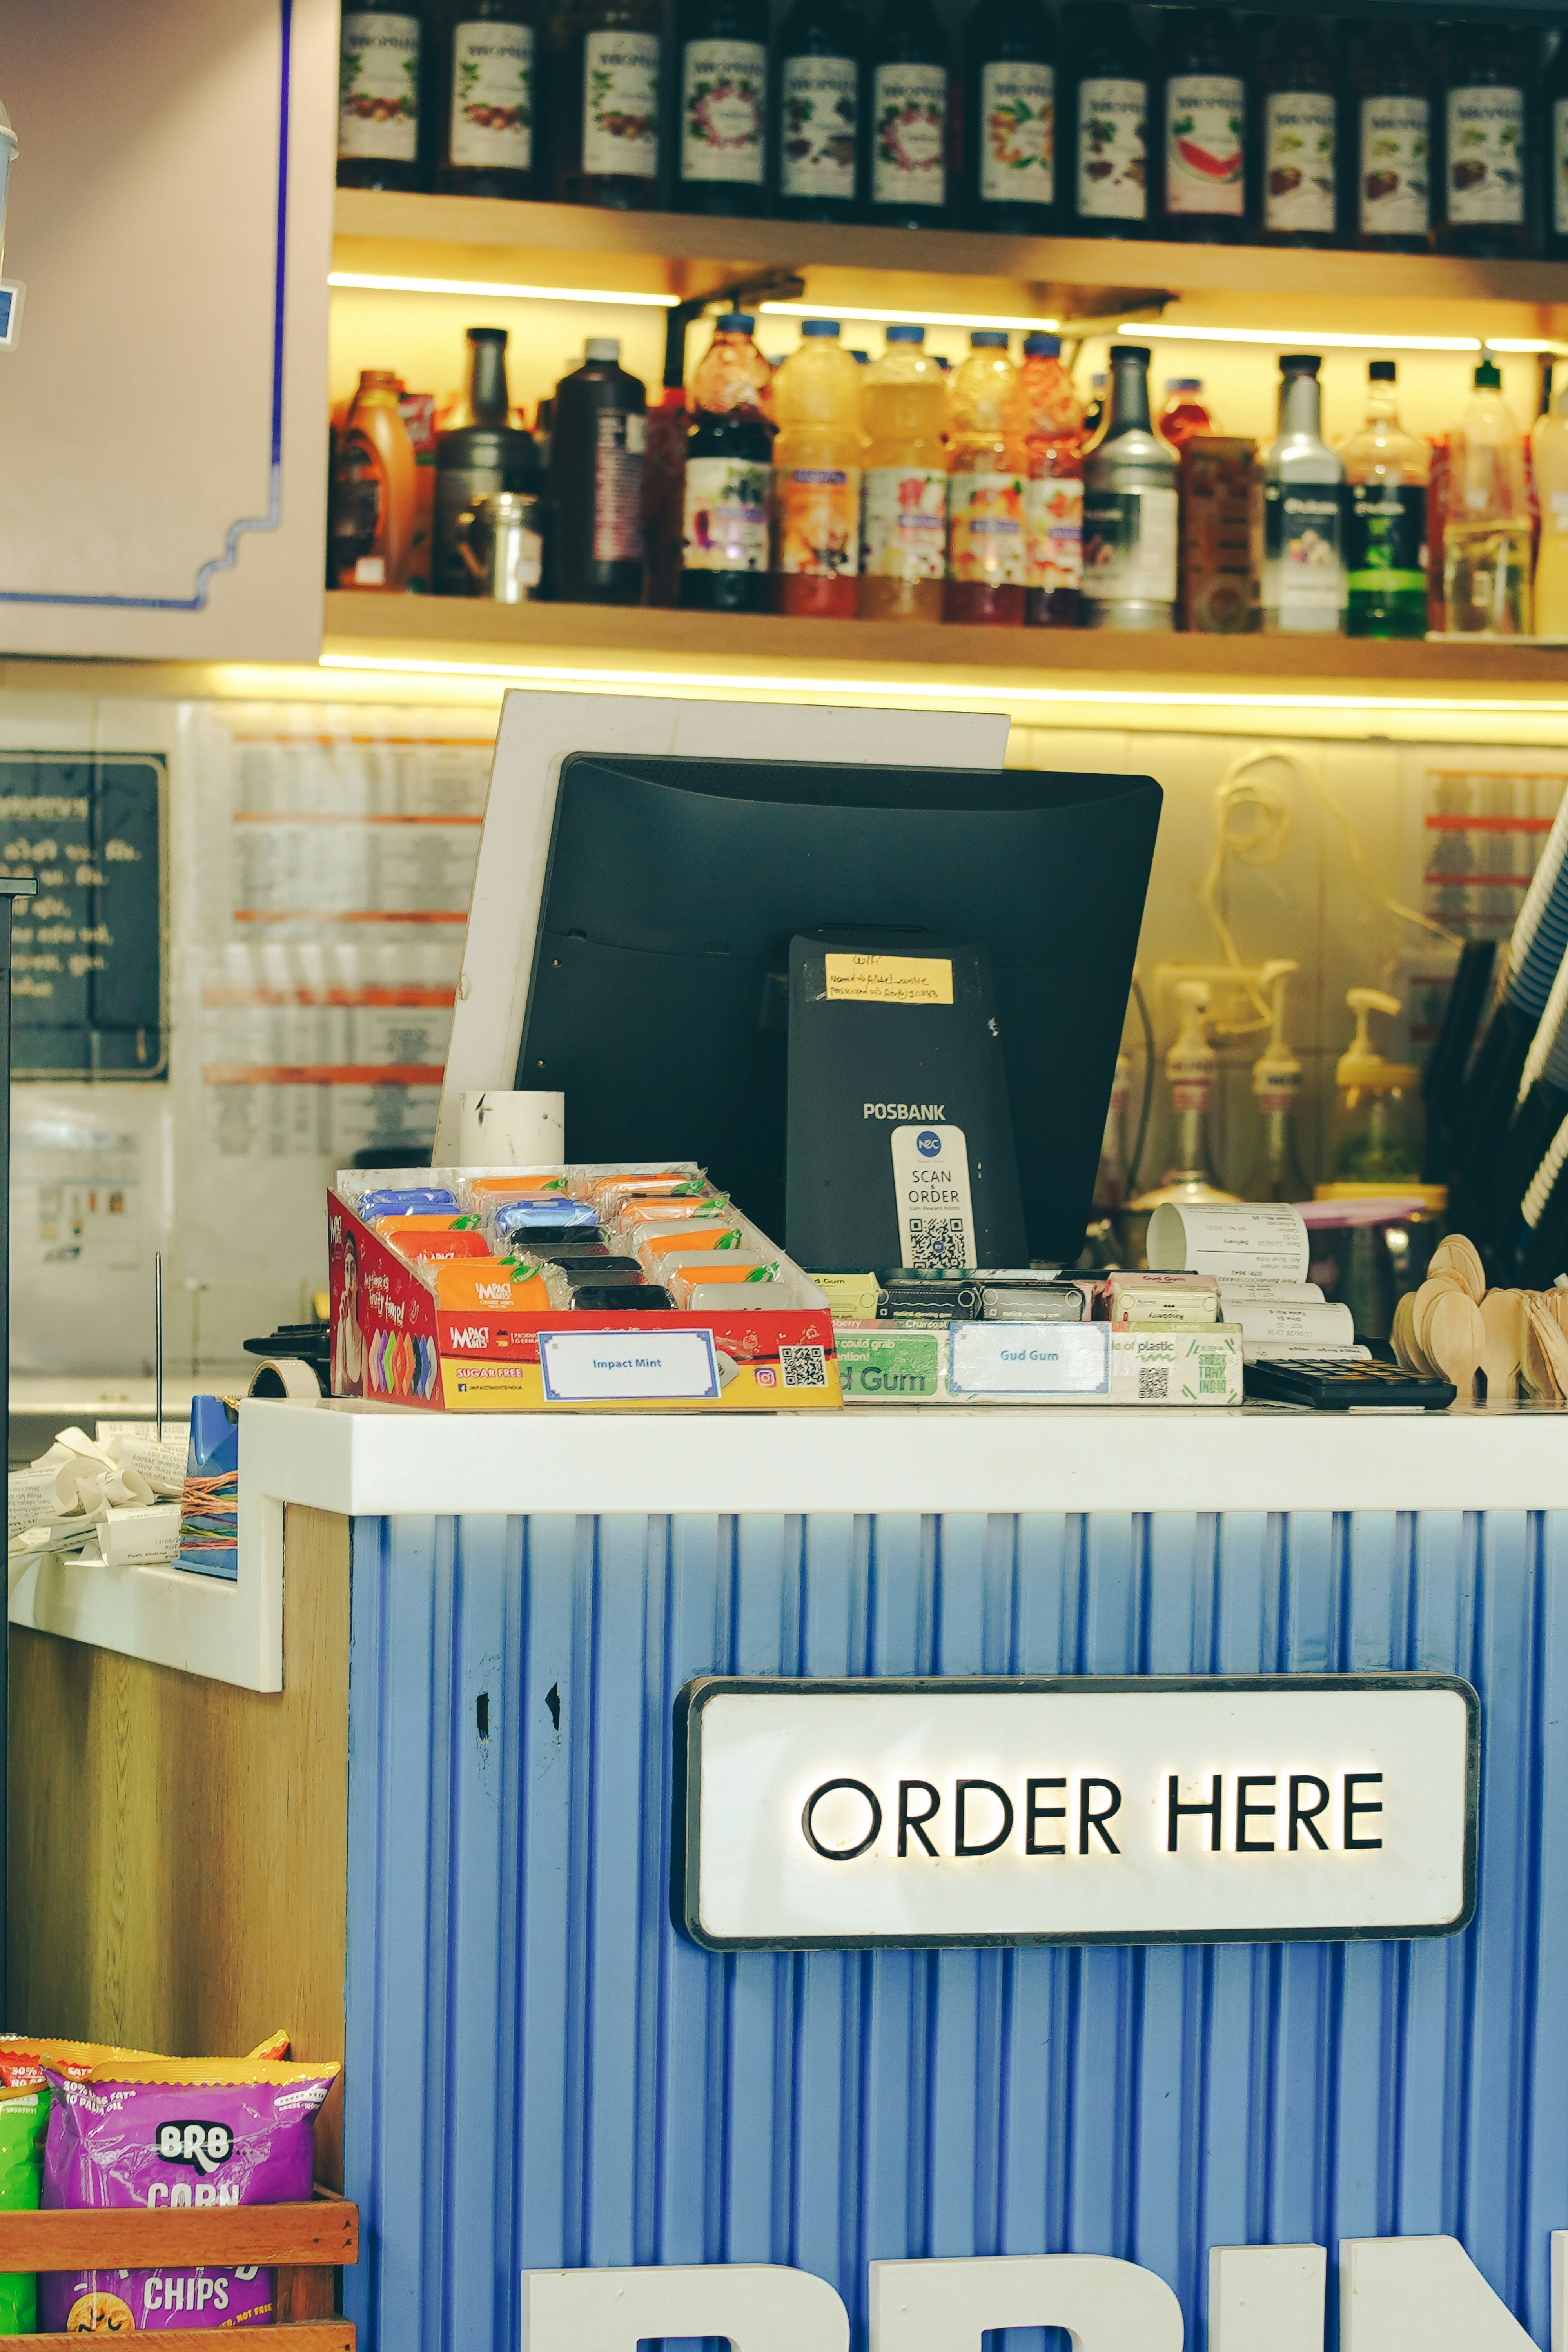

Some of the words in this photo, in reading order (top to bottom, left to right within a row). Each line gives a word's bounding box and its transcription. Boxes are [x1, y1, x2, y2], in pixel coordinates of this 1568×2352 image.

[863, 1103, 946, 1120] POSBANK
[912, 1171, 951, 1183] SCAN
[909, 1191, 960, 1203] ORDER
[831, 1319, 862, 1329] berry
[450, 1327, 489, 1349] IMPACT
[841, 1339, 869, 1348] could
[870, 1339, 896, 1351] grab
[1138, 1341, 1174, 1353] plastic
[837, 1351, 870, 1362] ention!
[1000, 1349, 1026, 1361] Gud
[1029, 1350, 1058, 1361] Gum
[593, 1359, 632, 1370] Impact
[636, 1359, 662, 1367] Mint
[456, 1368, 496, 1378] SUGAR
[498, 1368, 523, 1378] FREE
[861, 1366, 925, 1391] Gum
[802, 1778, 1122, 1861] ORDER
[1167, 1772, 1384, 1853] HERE
[11, 2079, 27, 2087] NO
[63, 2080, 87, 2095] 30%
[106, 2101, 124, 2113] OIL
[147, 2182, 240, 2208] CORN
[144, 2277, 229, 2310] CHIPS
[236, 2310, 252, 2323] NOT
[254, 2303, 273, 2316] FRIE
